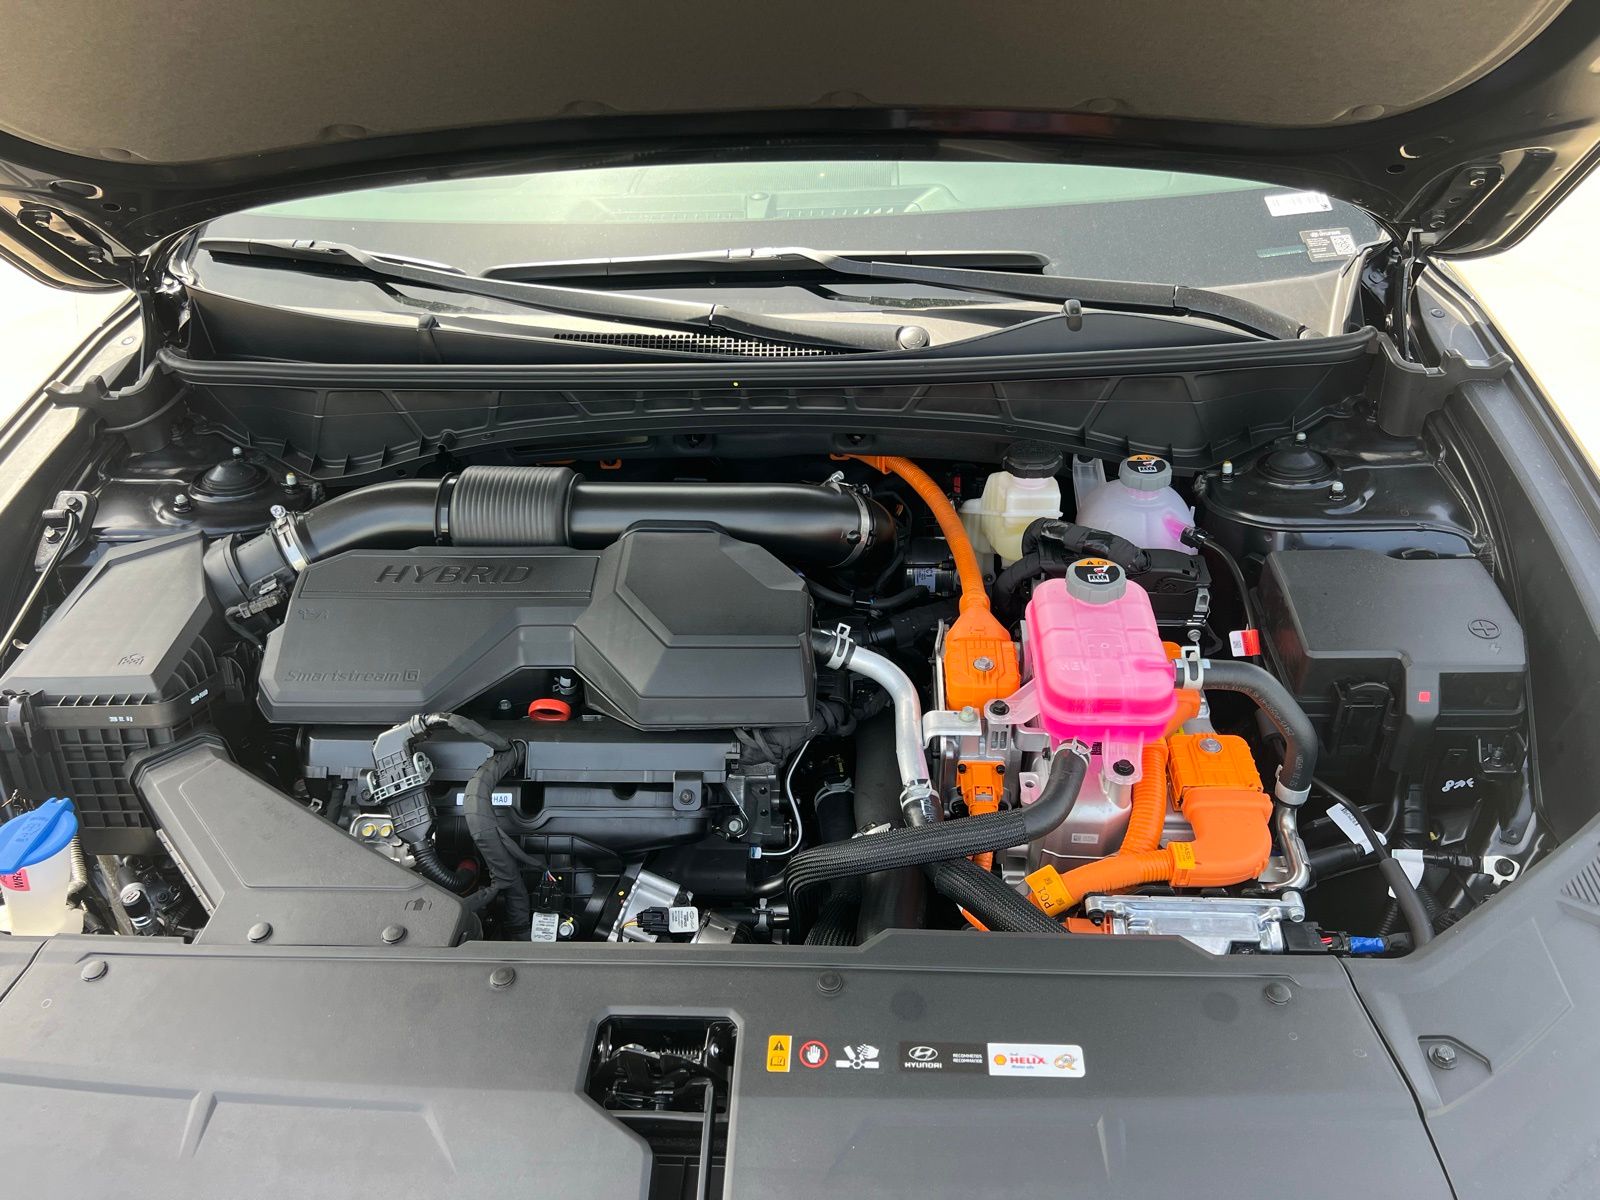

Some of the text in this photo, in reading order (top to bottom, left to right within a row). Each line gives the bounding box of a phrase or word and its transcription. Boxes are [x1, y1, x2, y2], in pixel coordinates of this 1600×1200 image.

[374, 564, 534, 585] HYBRID
[285, 669, 400, 682] Smartstream
[1037, 887, 1054, 909] PC1
[904, 1061, 942, 1069] HYUNDAI
[1010, 1056, 1046, 1065] HELIX
